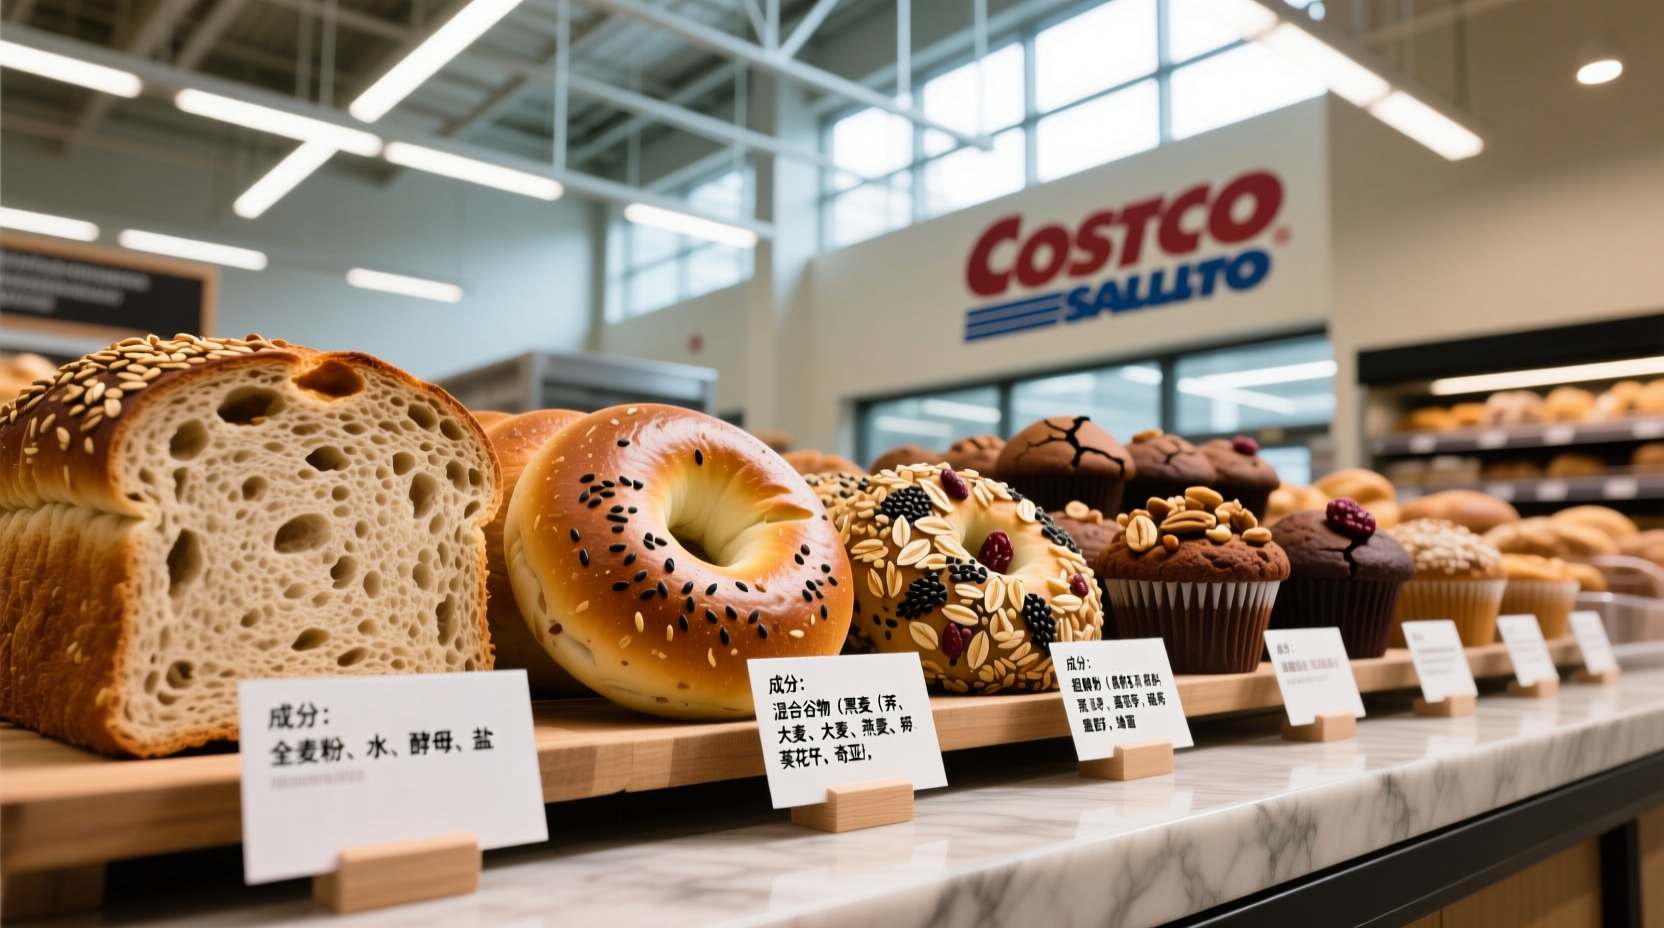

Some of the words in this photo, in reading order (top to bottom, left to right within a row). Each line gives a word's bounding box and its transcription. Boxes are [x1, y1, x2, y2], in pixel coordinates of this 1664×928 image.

[966, 169, 1284, 298] COSTCO
[769, 674, 805, 695] 成分：
[268, 702, 330, 730] 成分：
[270, 726, 495, 768] 全麦粉、水、酵母、盐
